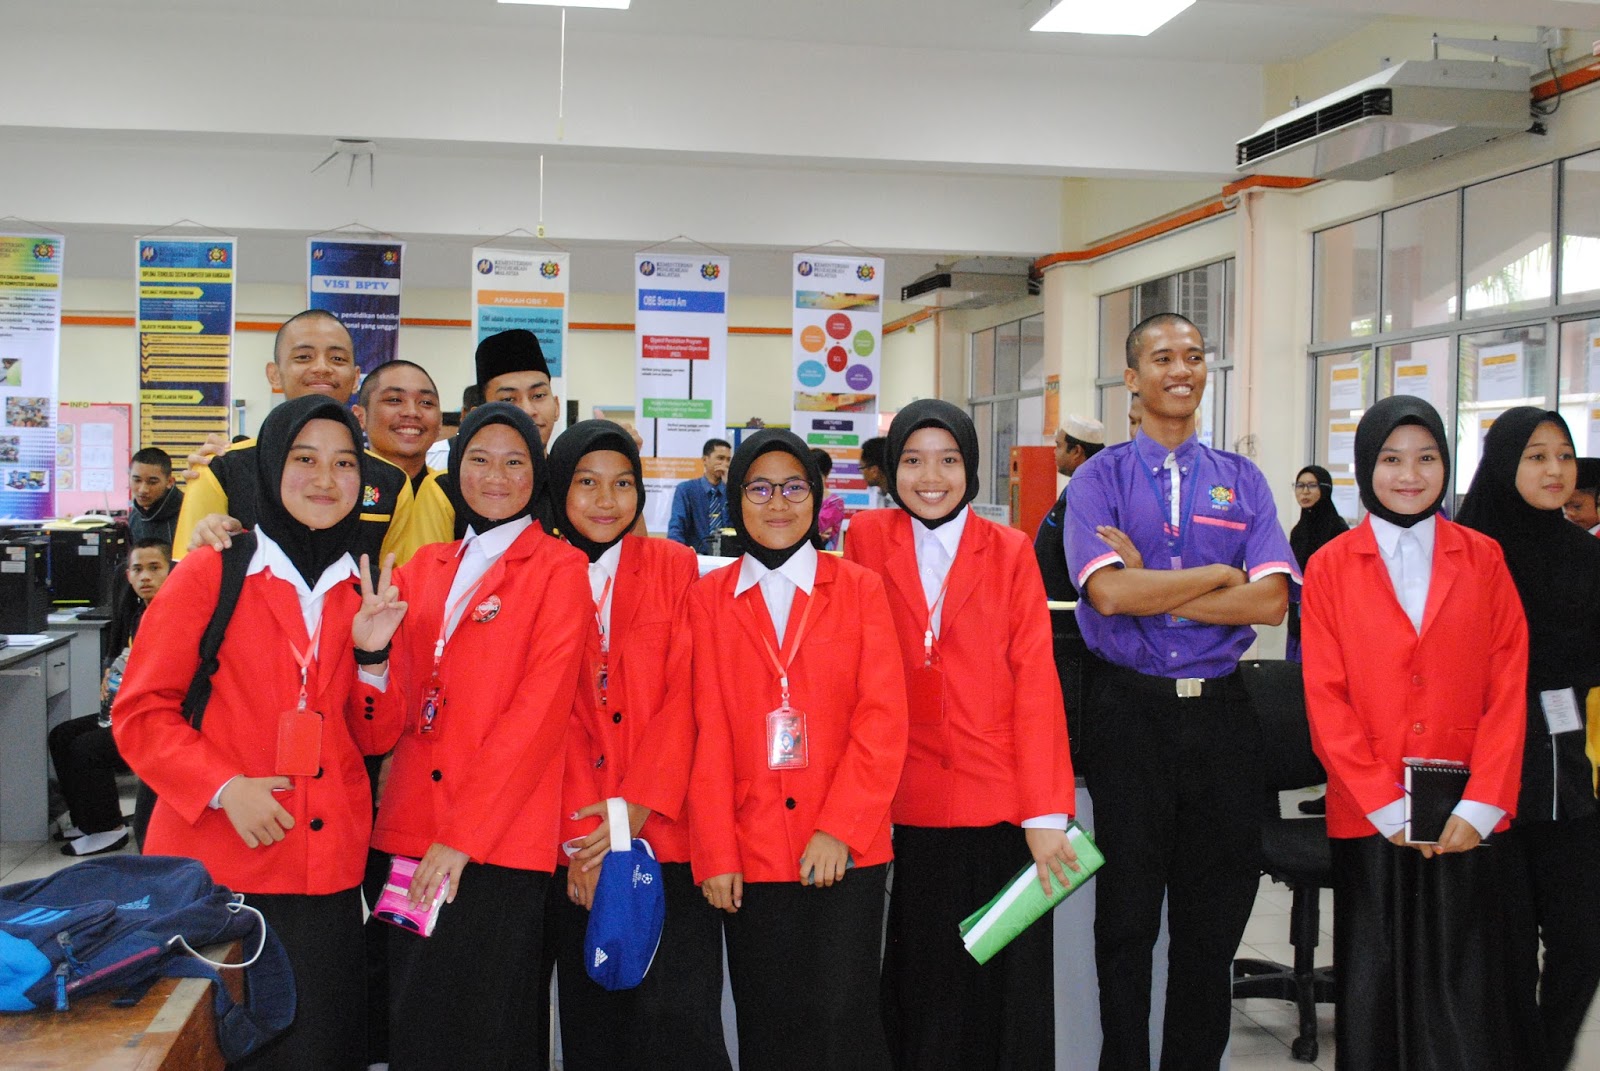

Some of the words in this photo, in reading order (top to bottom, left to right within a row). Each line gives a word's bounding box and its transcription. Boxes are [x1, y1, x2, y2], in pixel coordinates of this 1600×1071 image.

[323, 280, 350, 288] VISI
[356, 281, 389, 290] BPTV
[643, 295, 657, 306] OBE
[657, 296, 676, 306] Secara
[676, 297, 687, 306] Am
